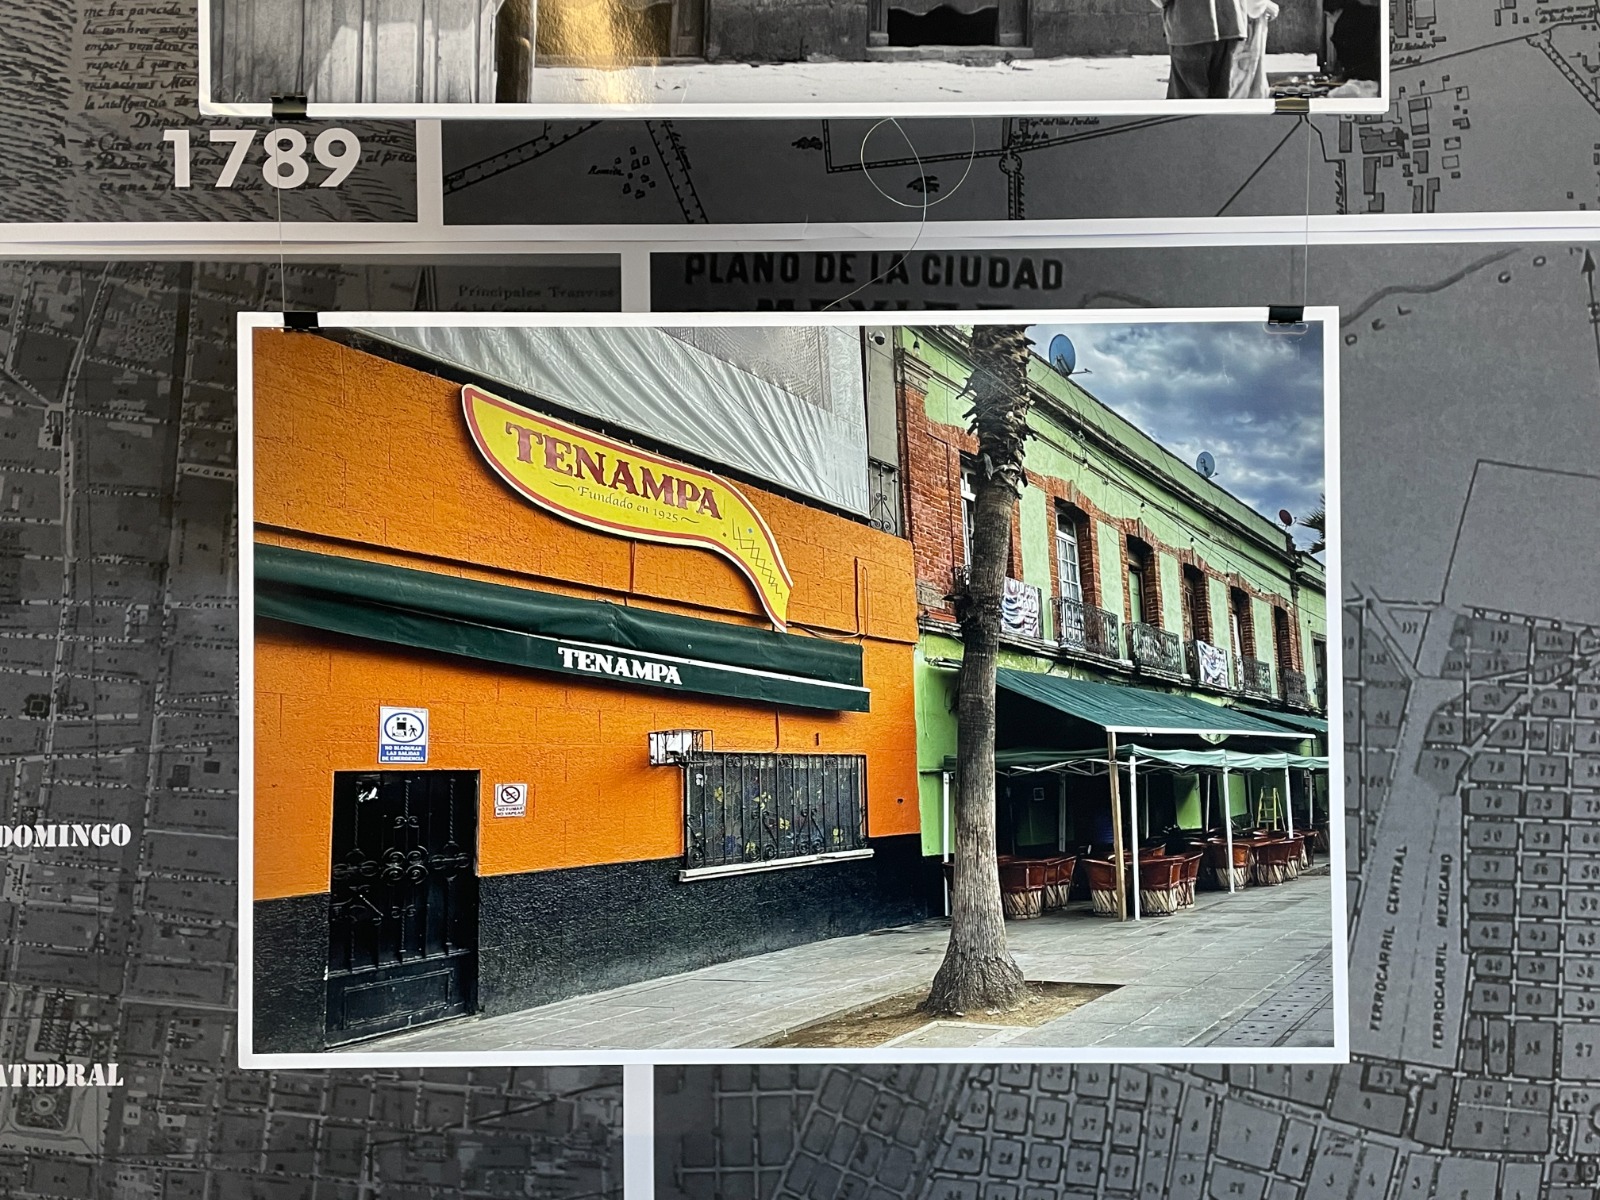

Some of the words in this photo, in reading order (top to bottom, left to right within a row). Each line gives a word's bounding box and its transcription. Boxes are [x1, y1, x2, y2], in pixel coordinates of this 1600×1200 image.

[163, 127, 362, 190] 1789
[685, 252, 801, 286] PLANO
[815, 253, 857, 284] DE
[868, 253, 911, 285] LA
[920, 254, 1064, 291] CIUDAD
[505, 421, 723, 521] TENAMPA
[577, 485, 634, 511] Fundado
[636, 504, 650, 514] en
[653, 507, 680, 524] 1925
[557, 646, 683, 687] TENAMPA
[0, 823, 132, 848] DOMINGO
[1385, 845, 1408, 915] CENTRAL
[1436, 854, 1454, 929] MEXICANO
[1369, 925, 1396, 1031] FERROCARRIL
[1432, 942, 1448, 1050] FERROCARRIL
